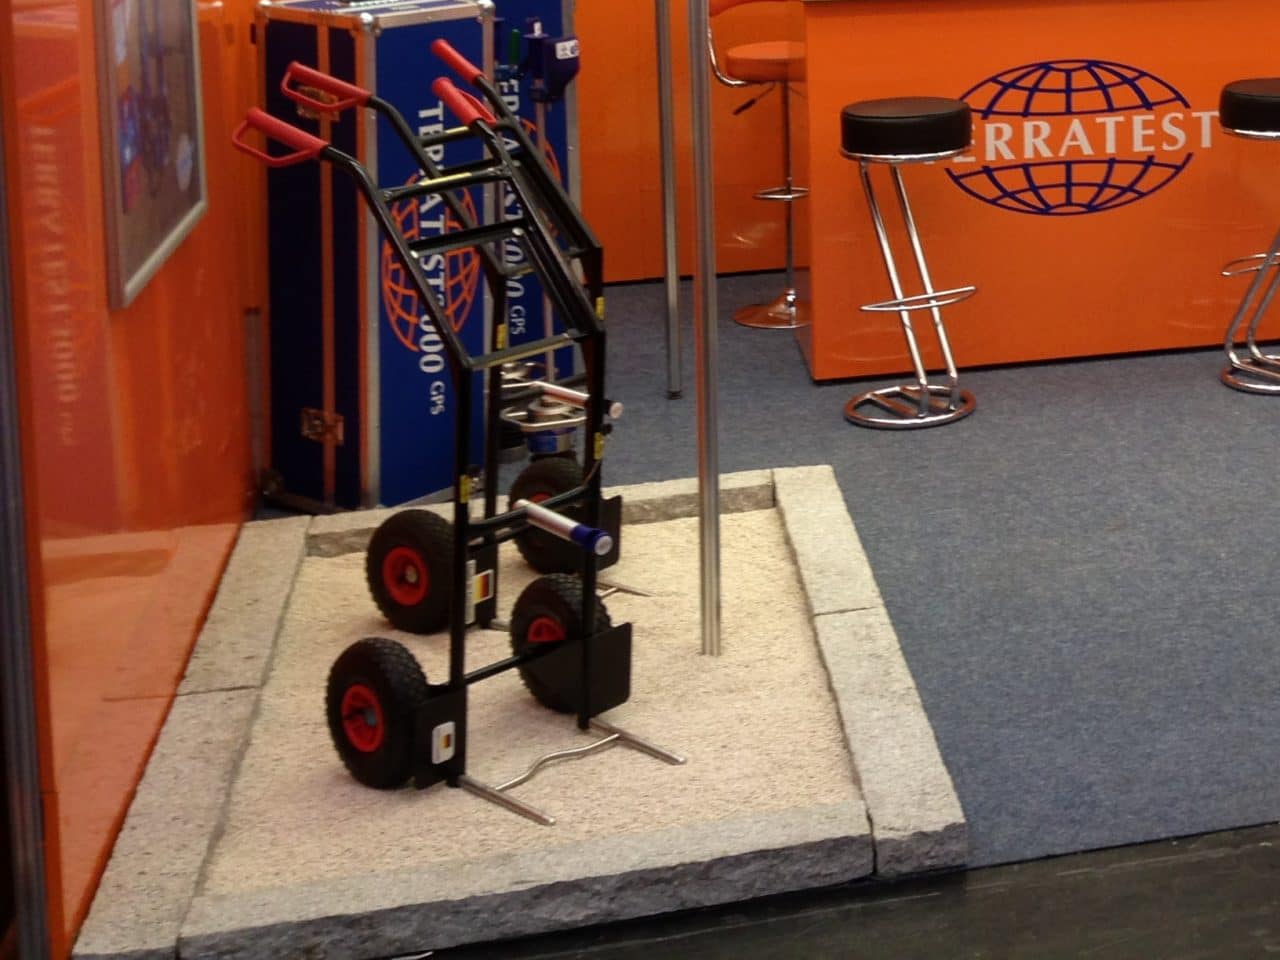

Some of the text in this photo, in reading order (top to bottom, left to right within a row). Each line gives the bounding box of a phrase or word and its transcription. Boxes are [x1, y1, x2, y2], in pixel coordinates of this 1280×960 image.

[951, 111, 1219, 164] RRATEST
[510, 304, 527, 335] GPS
[429, 380, 446, 416] GPS
